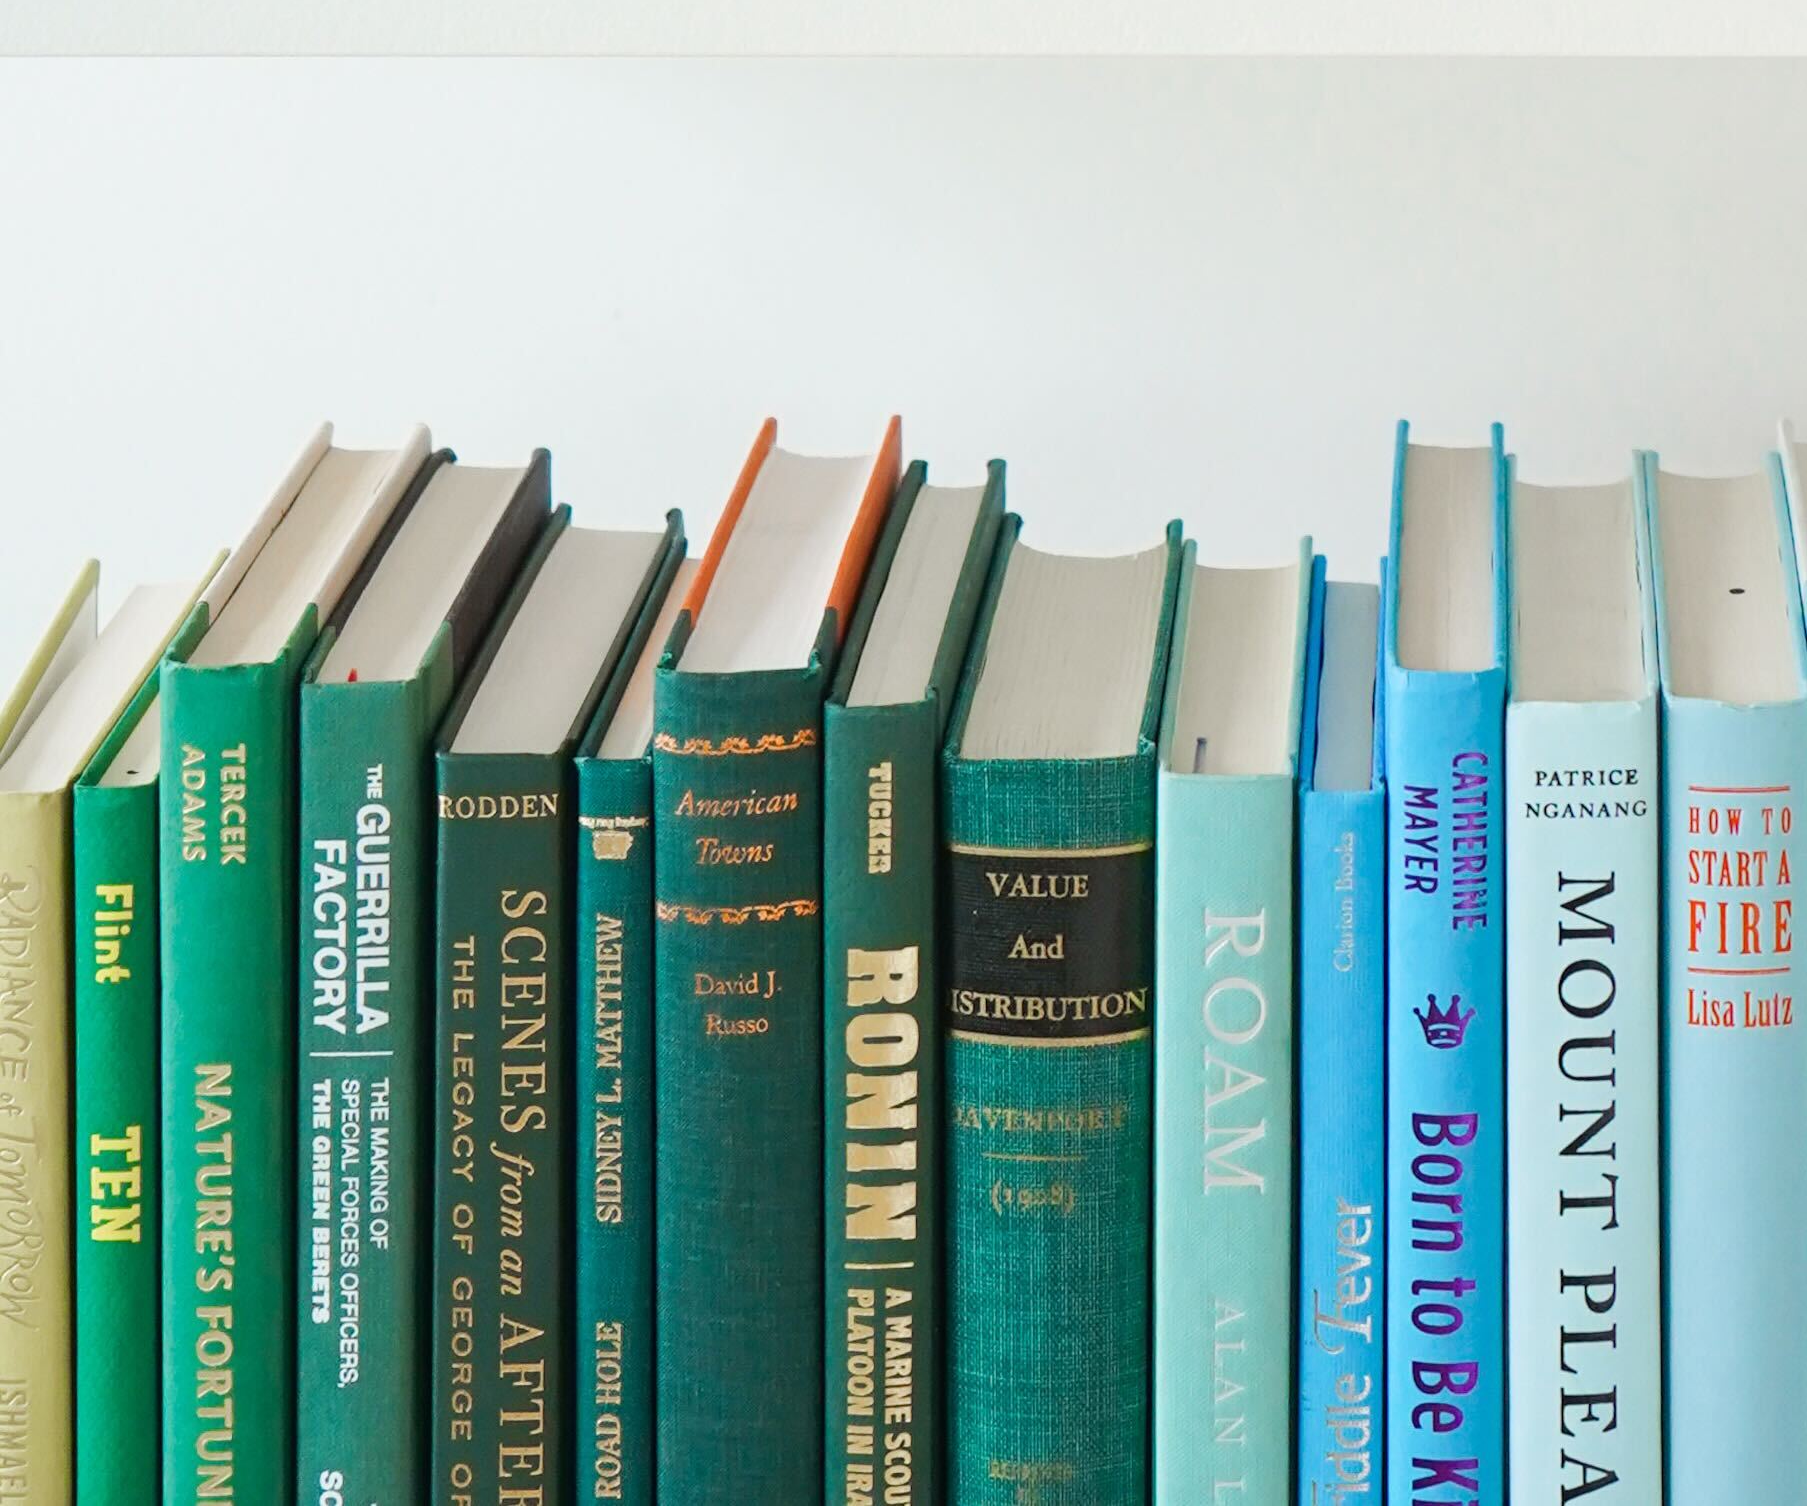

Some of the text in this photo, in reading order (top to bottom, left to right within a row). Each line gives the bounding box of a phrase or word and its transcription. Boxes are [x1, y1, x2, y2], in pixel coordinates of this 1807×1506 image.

[180, 744, 207, 862] ADAMS
[219, 743, 247, 865] TERCEK
[1525, 800, 1648, 819] NGANANG
[1534, 769, 1639, 787] PATRICE
[355, 764, 391, 1035] THE GUERRILLA
[985, 871, 1089, 899] VALUE
[1404, 784, 1438, 895] MAYER
[1451, 751, 1488, 931] CATHERINE
[1688, 850, 1769, 888] START
[94, 884, 134, 985] Flint
[312, 838, 347, 1035] FACTORY
[1008, 934, 1064, 960] And
[1332, 831, 1355, 974] Clarion Books
[1687, 899, 1793, 955] FIRE
[453, 936, 475, 1010] THE
[500, 888, 548, 1133] SCENES
[595, 912, 623, 1070] MATTHEW
[452, 1032, 475, 1183] LEGACY
[846, 945, 920, 1241] RONIN
[1204, 907, 1268, 1197] ROAM
[1558, 870, 1619, 1231] MOUNT
[90, 1125, 141, 1244] TEN
[340, 1079, 361, 1170] SPECIAL
[368, 1127, 389, 1215] MAKING
[451, 1203, 474, 1255] OF
[1313, 1194, 1374, 1356] Fever
[1411, 1112, 1479, 1434] Born Be
[450, 1275, 474, 1441] GEORGE
[847, 1288, 874, 1416] PLATOON
[883, 1315, 913, 1425] MARINE
[1214, 1292, 1248, 1448] ALAN
